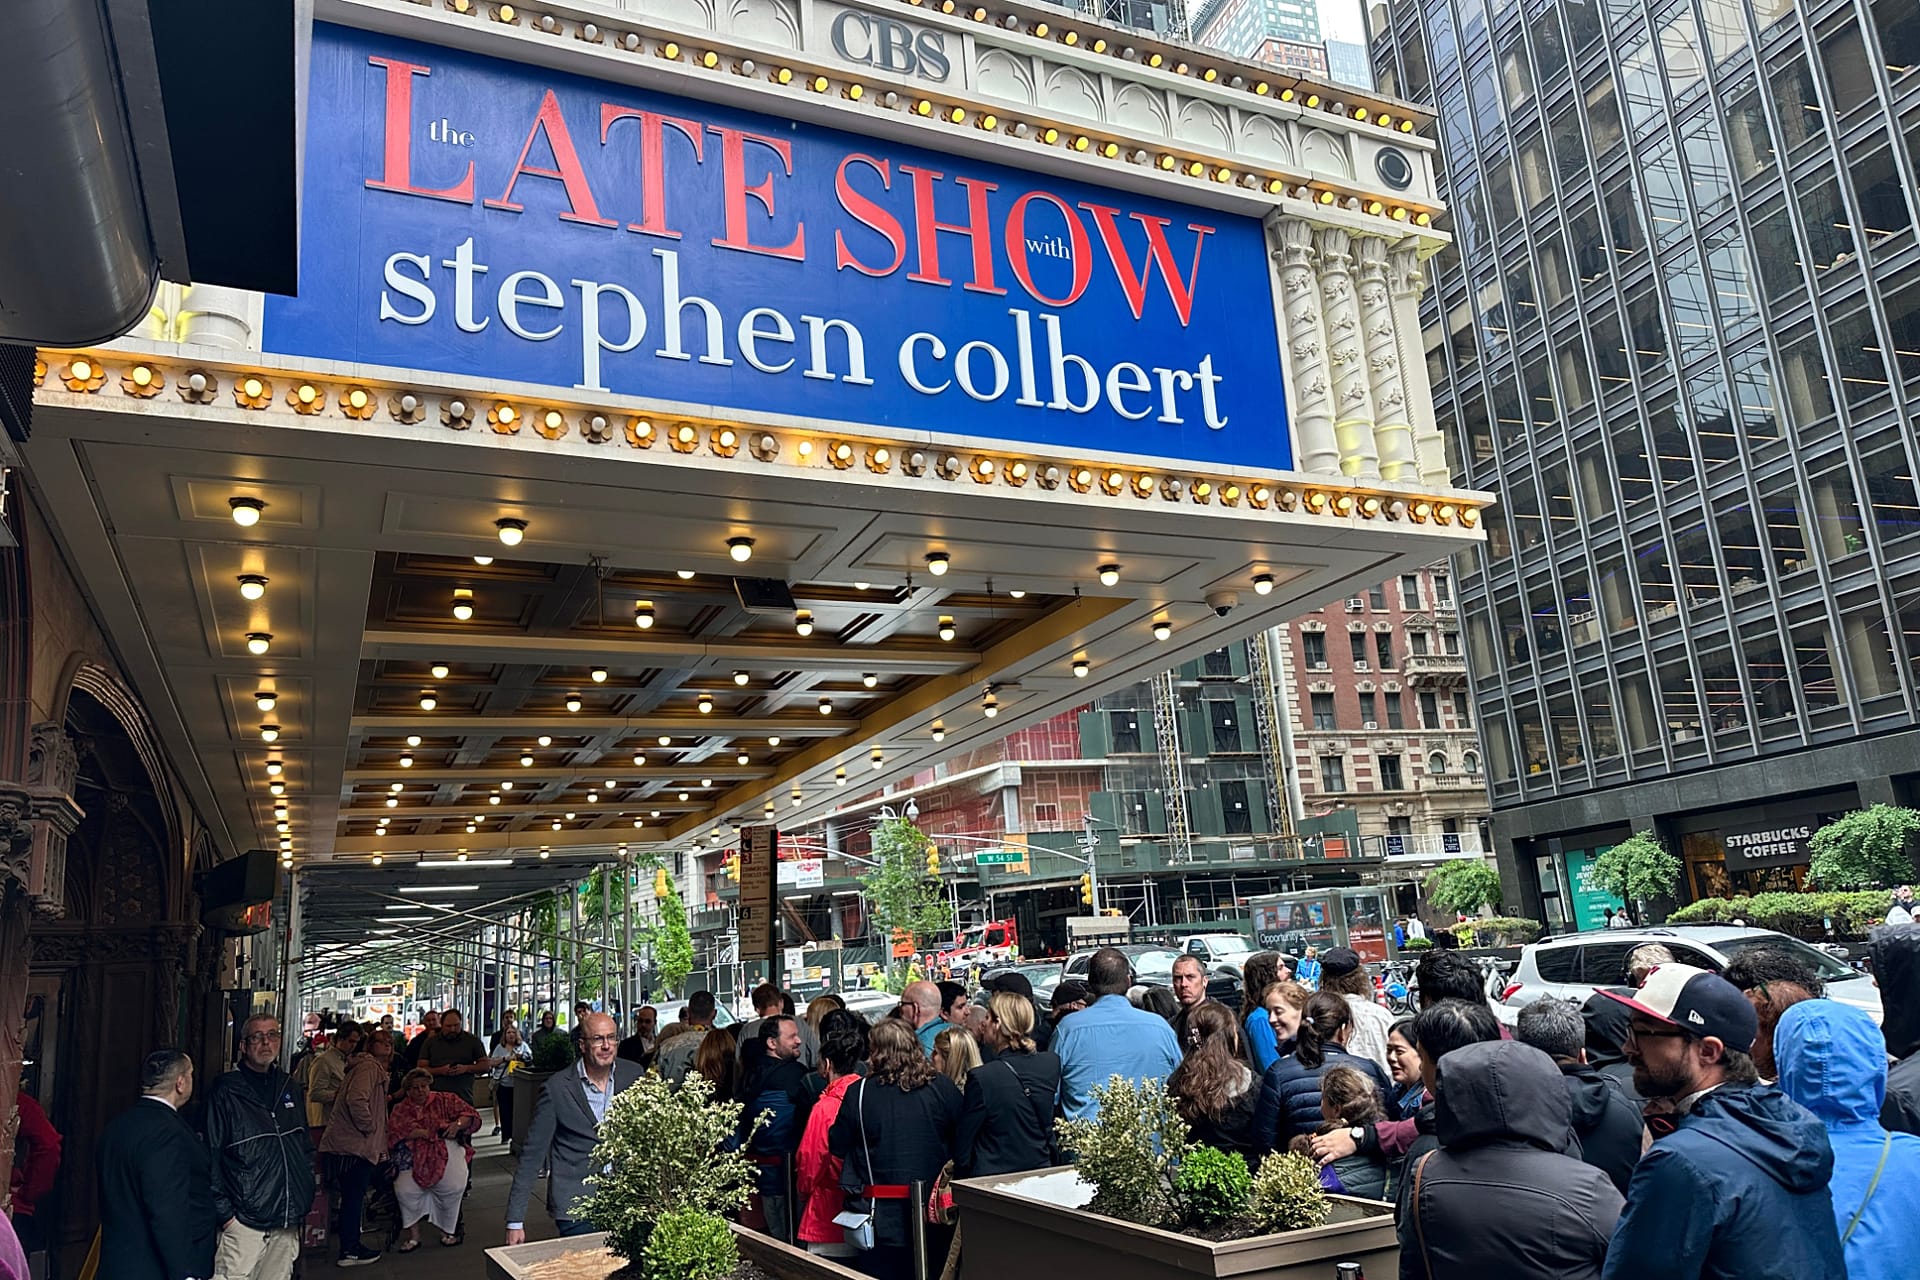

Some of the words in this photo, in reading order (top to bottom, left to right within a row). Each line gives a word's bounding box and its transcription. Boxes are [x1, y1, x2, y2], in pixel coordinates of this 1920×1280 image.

[831, 9, 950, 82] CBS
[428, 118, 476, 149] the
[364, 55, 805, 262] LATE
[835, 153, 1216, 327] SHOW
[1025, 235, 1072, 261] with
[379, 237, 875, 393] stephen
[898, 308, 1228, 430] colbert
[1726, 826, 1810, 848] STARBUCKS
[743, 852, 750, 864] 3
[1743, 841, 1797, 858] COFFEE
[742, 908, 749, 919] 6
[1260, 931, 1299, 944] Opportunity
